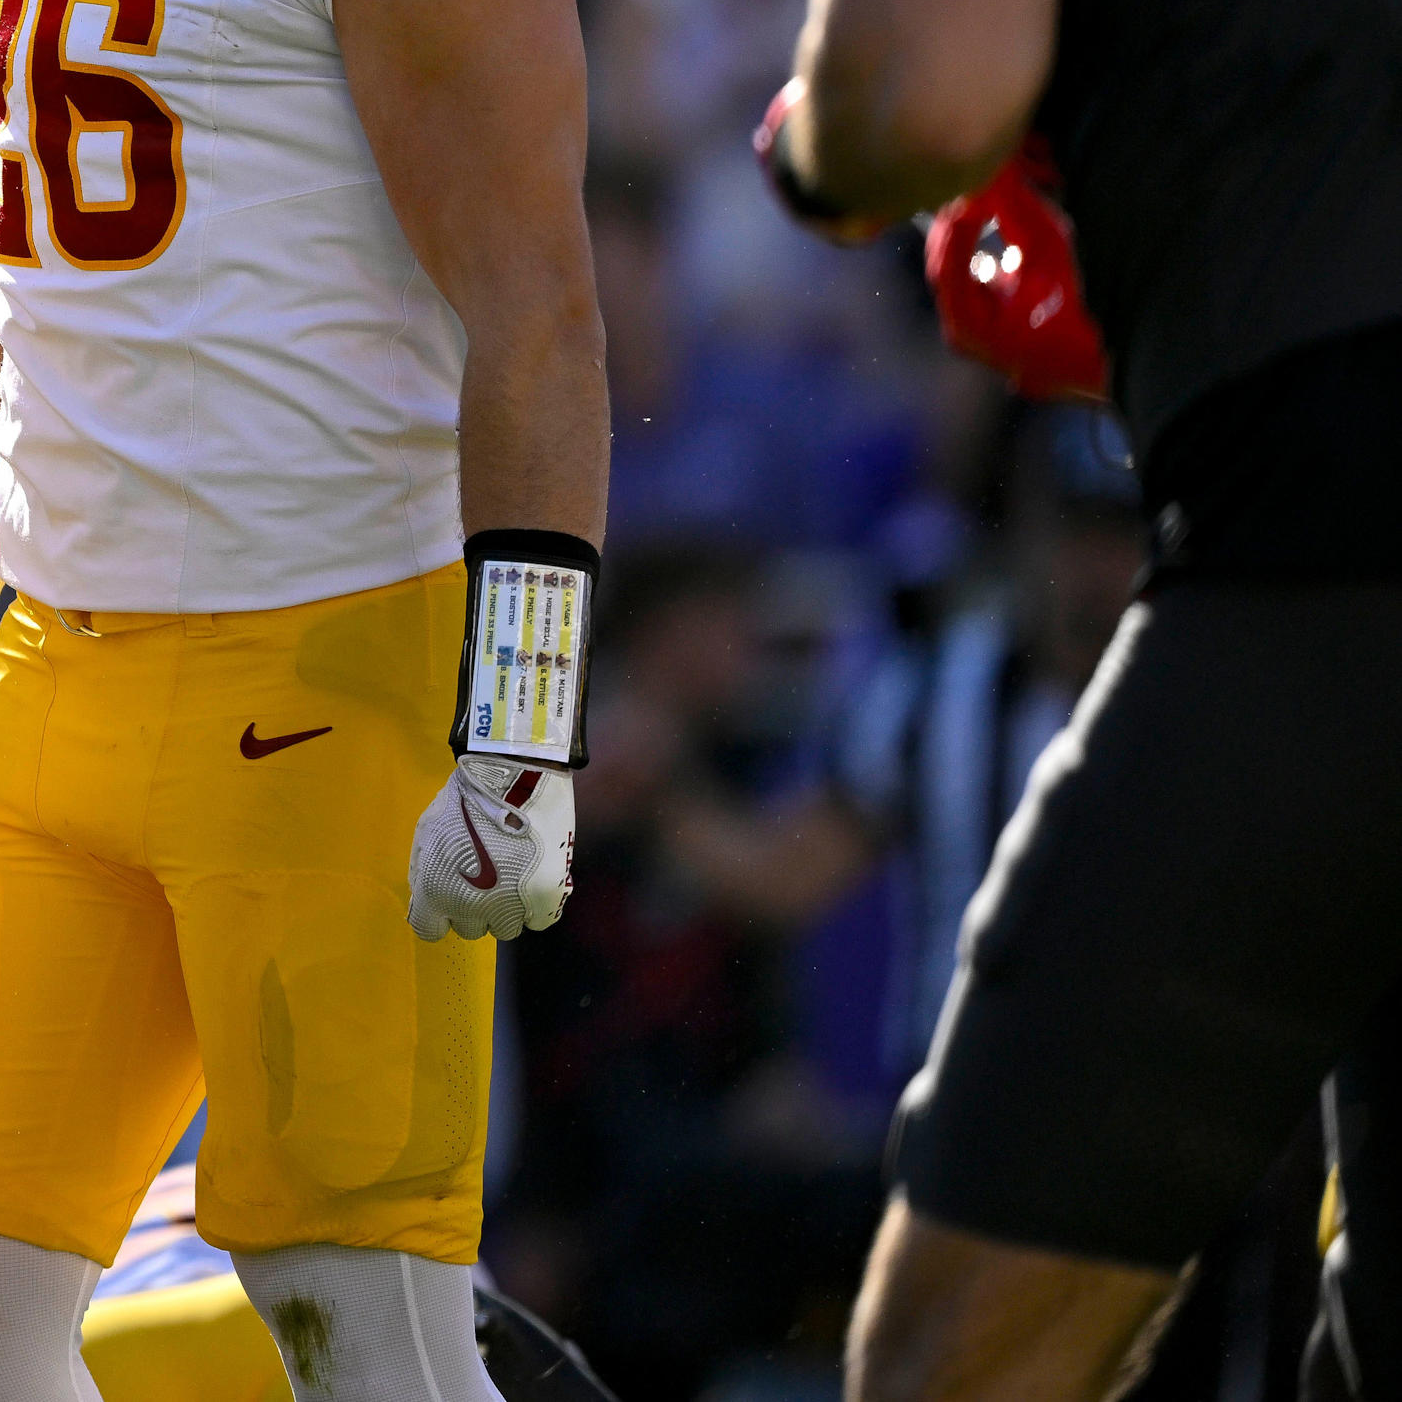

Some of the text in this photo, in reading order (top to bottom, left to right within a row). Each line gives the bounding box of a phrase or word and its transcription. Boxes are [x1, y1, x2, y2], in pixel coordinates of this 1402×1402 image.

[488, 594, 496, 616] PINCH
[526, 597, 534, 625] PHILLY
[488, 619, 494, 628] 33
[486, 631, 494, 654] PRESS
[498, 675, 506, 701] SMOKE
[557, 679, 565, 717] MUSTANG
[476, 704, 491, 737] TCU
